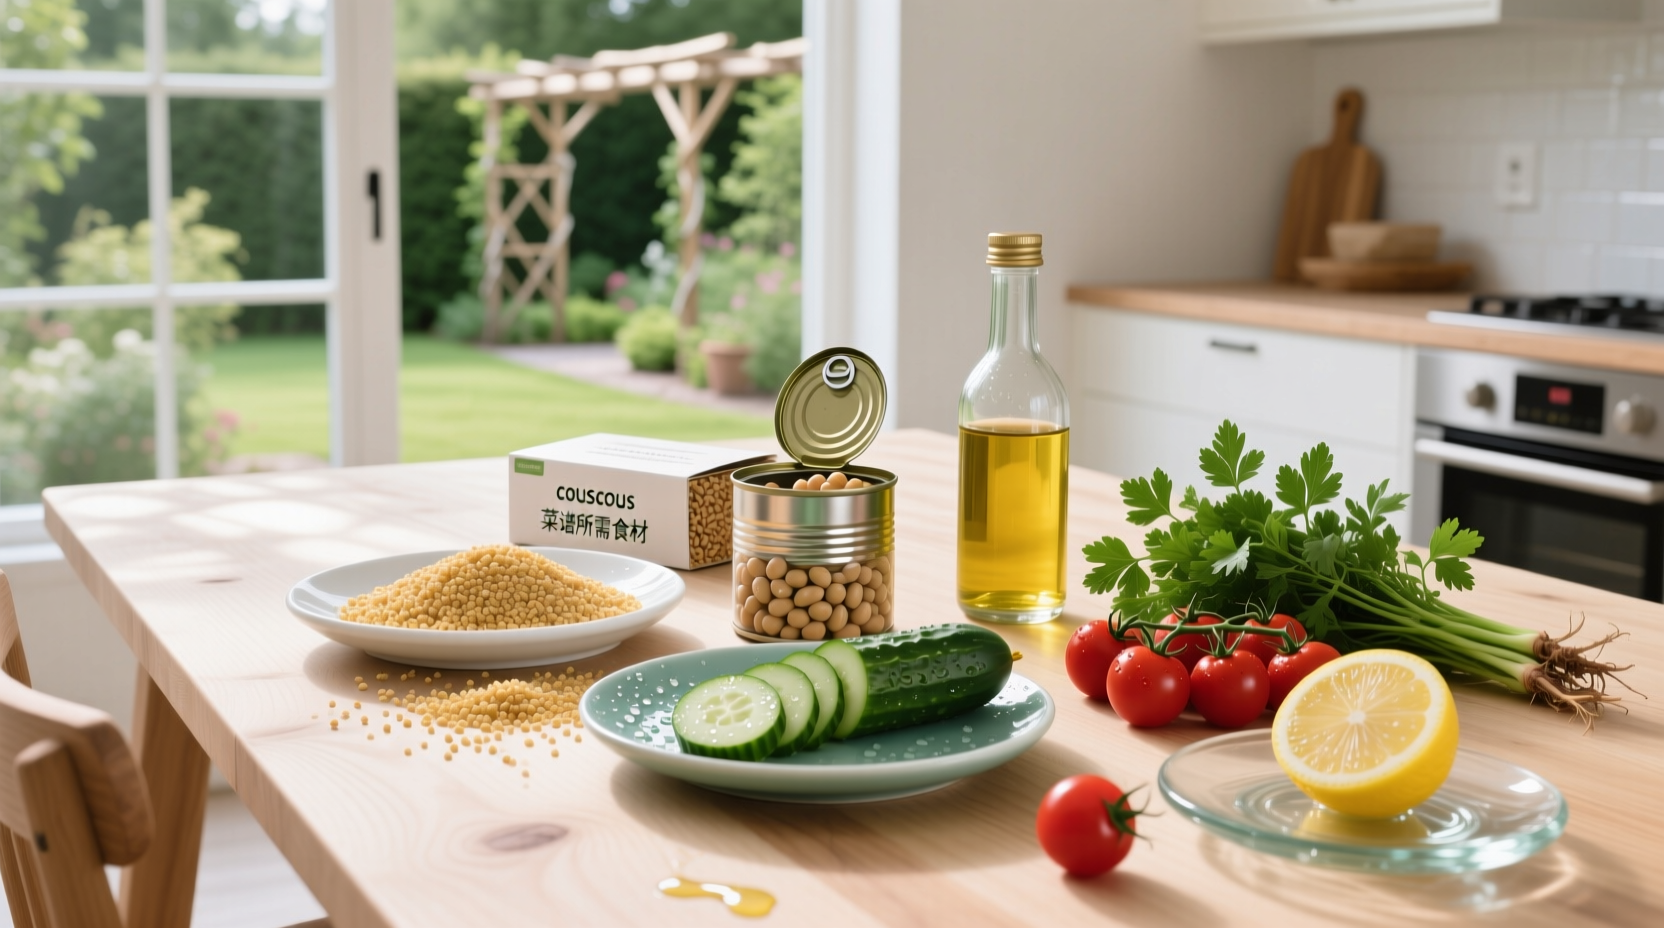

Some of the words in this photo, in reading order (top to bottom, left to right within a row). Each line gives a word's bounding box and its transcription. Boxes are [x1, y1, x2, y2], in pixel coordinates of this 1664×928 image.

[541, 508, 648, 544] 菜谱所需食材
